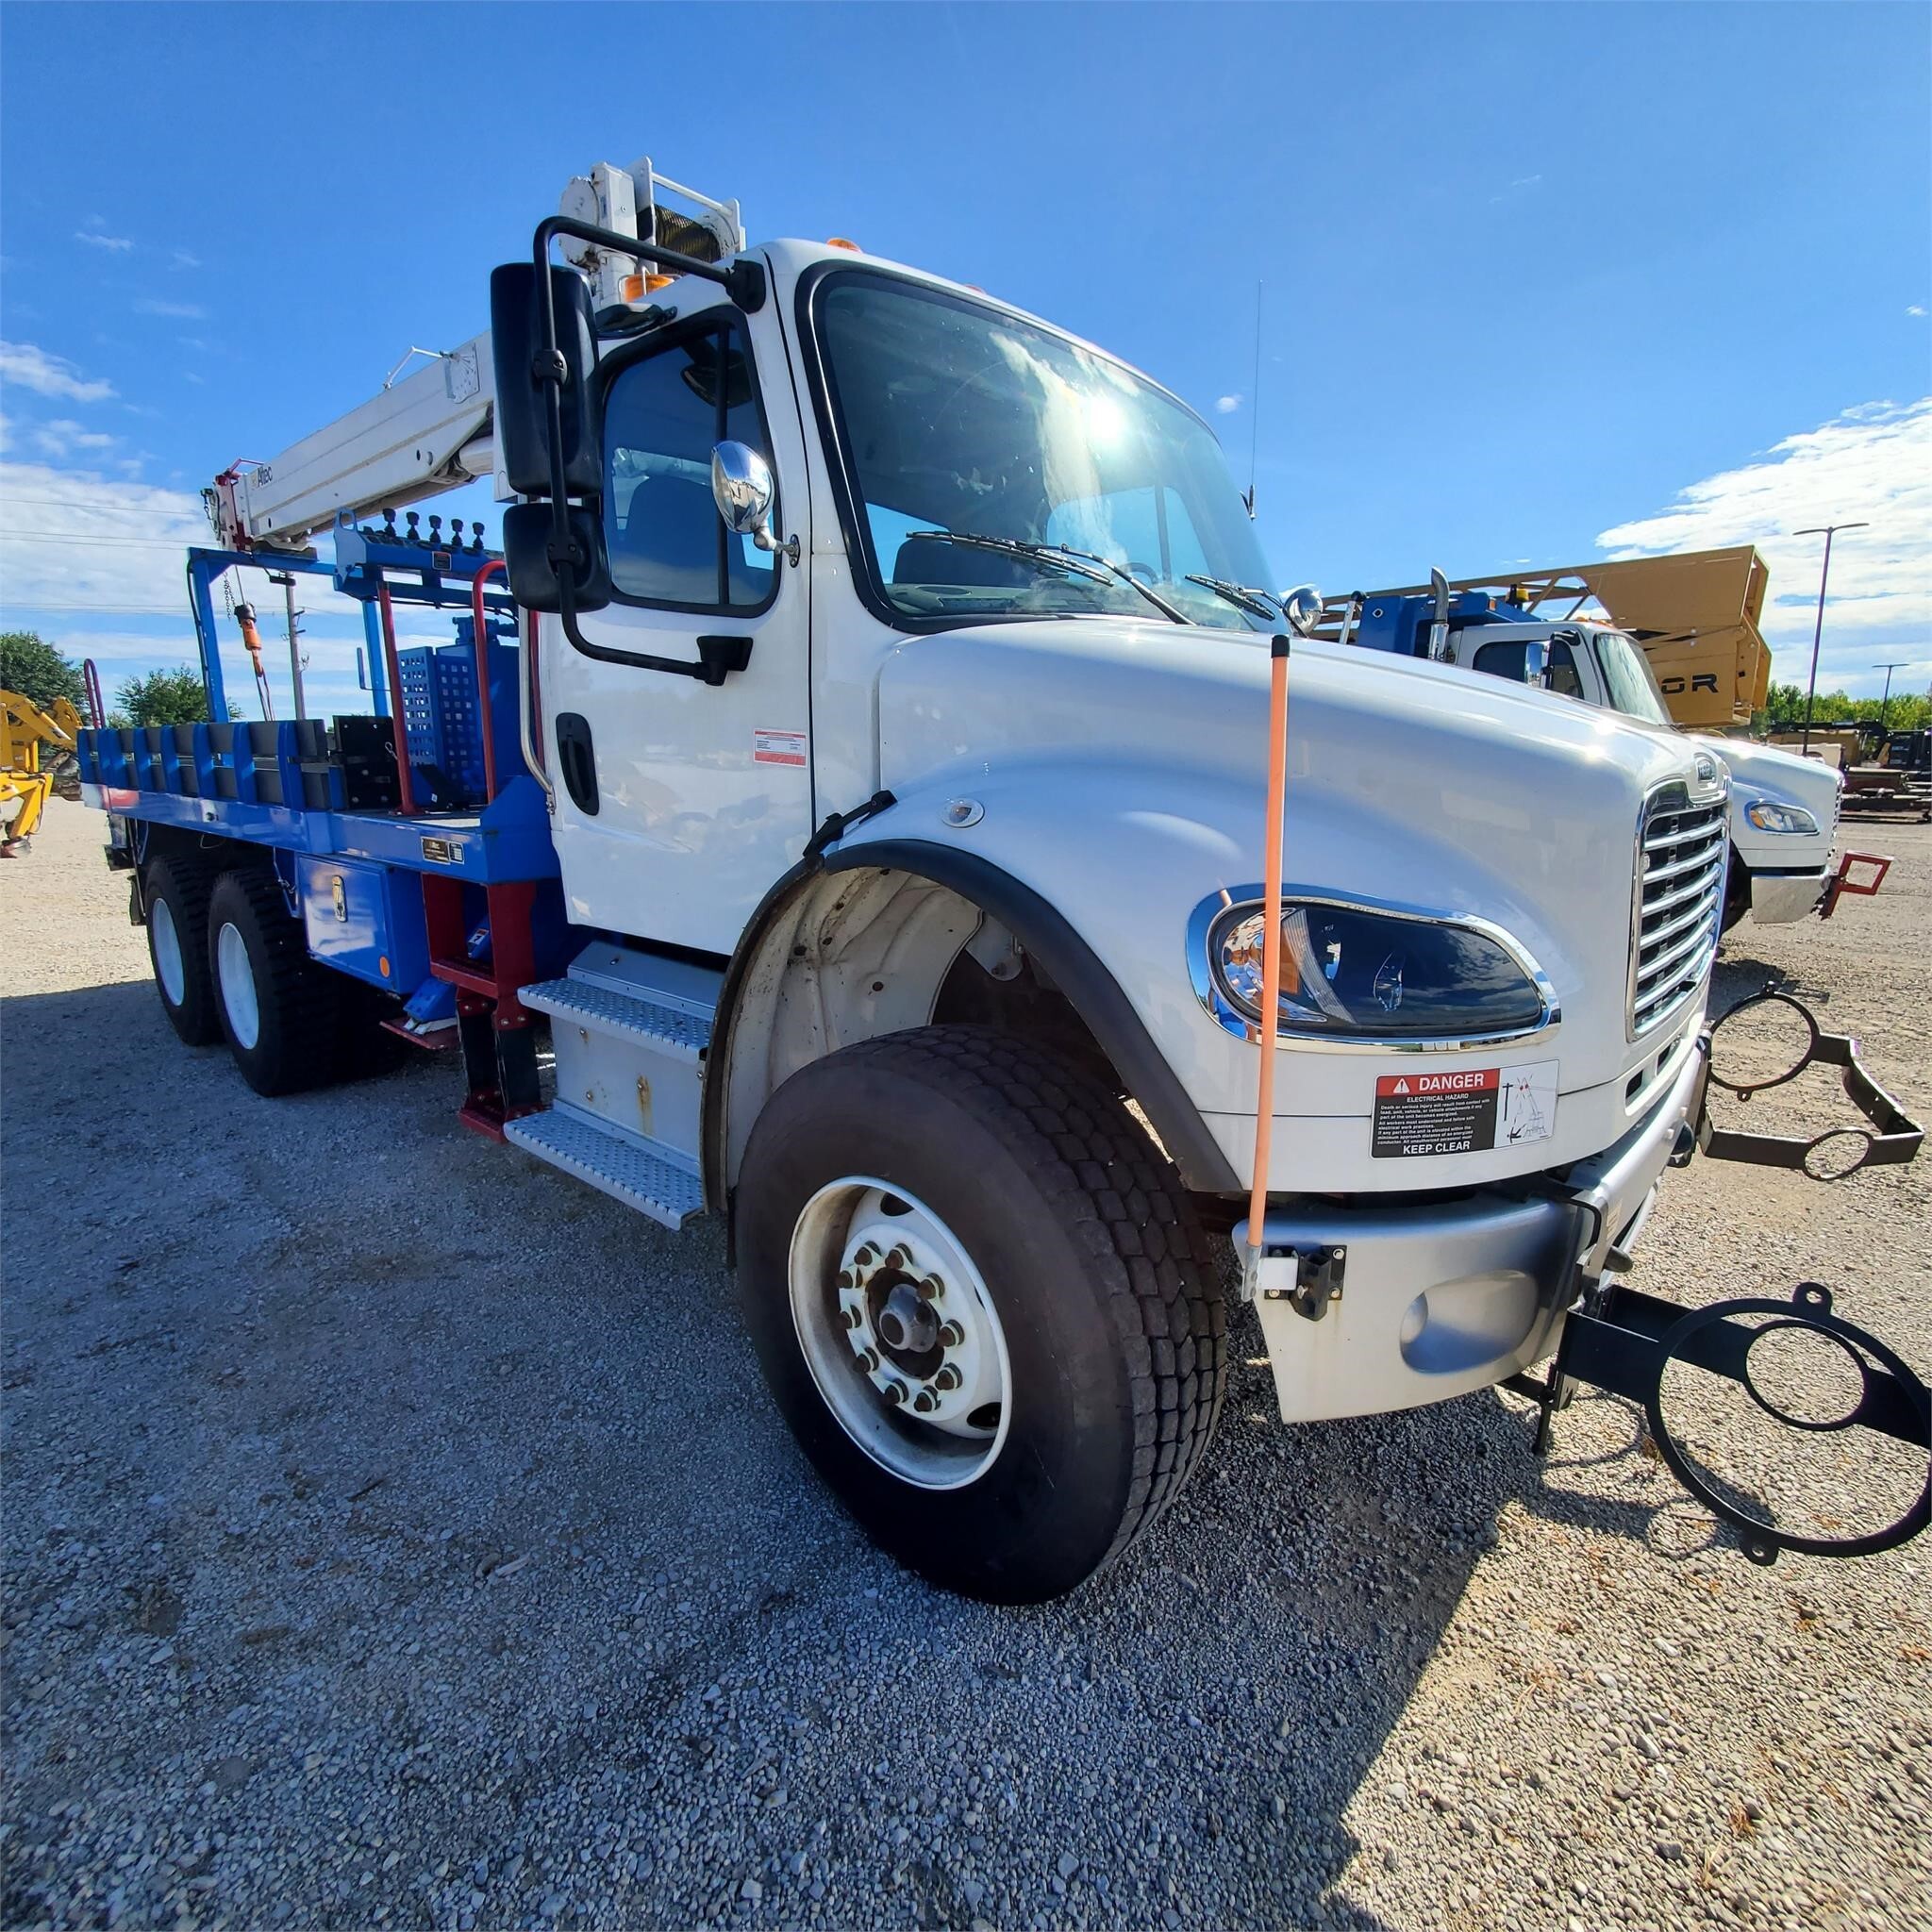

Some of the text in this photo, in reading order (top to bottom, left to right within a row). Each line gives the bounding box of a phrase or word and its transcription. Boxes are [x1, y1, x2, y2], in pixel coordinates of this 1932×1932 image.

[1660, 673, 1720, 695] OR
[1419, 1074, 1485, 1091] DANGER
[1404, 1141, 1471, 1155] KEEP CLEAR
